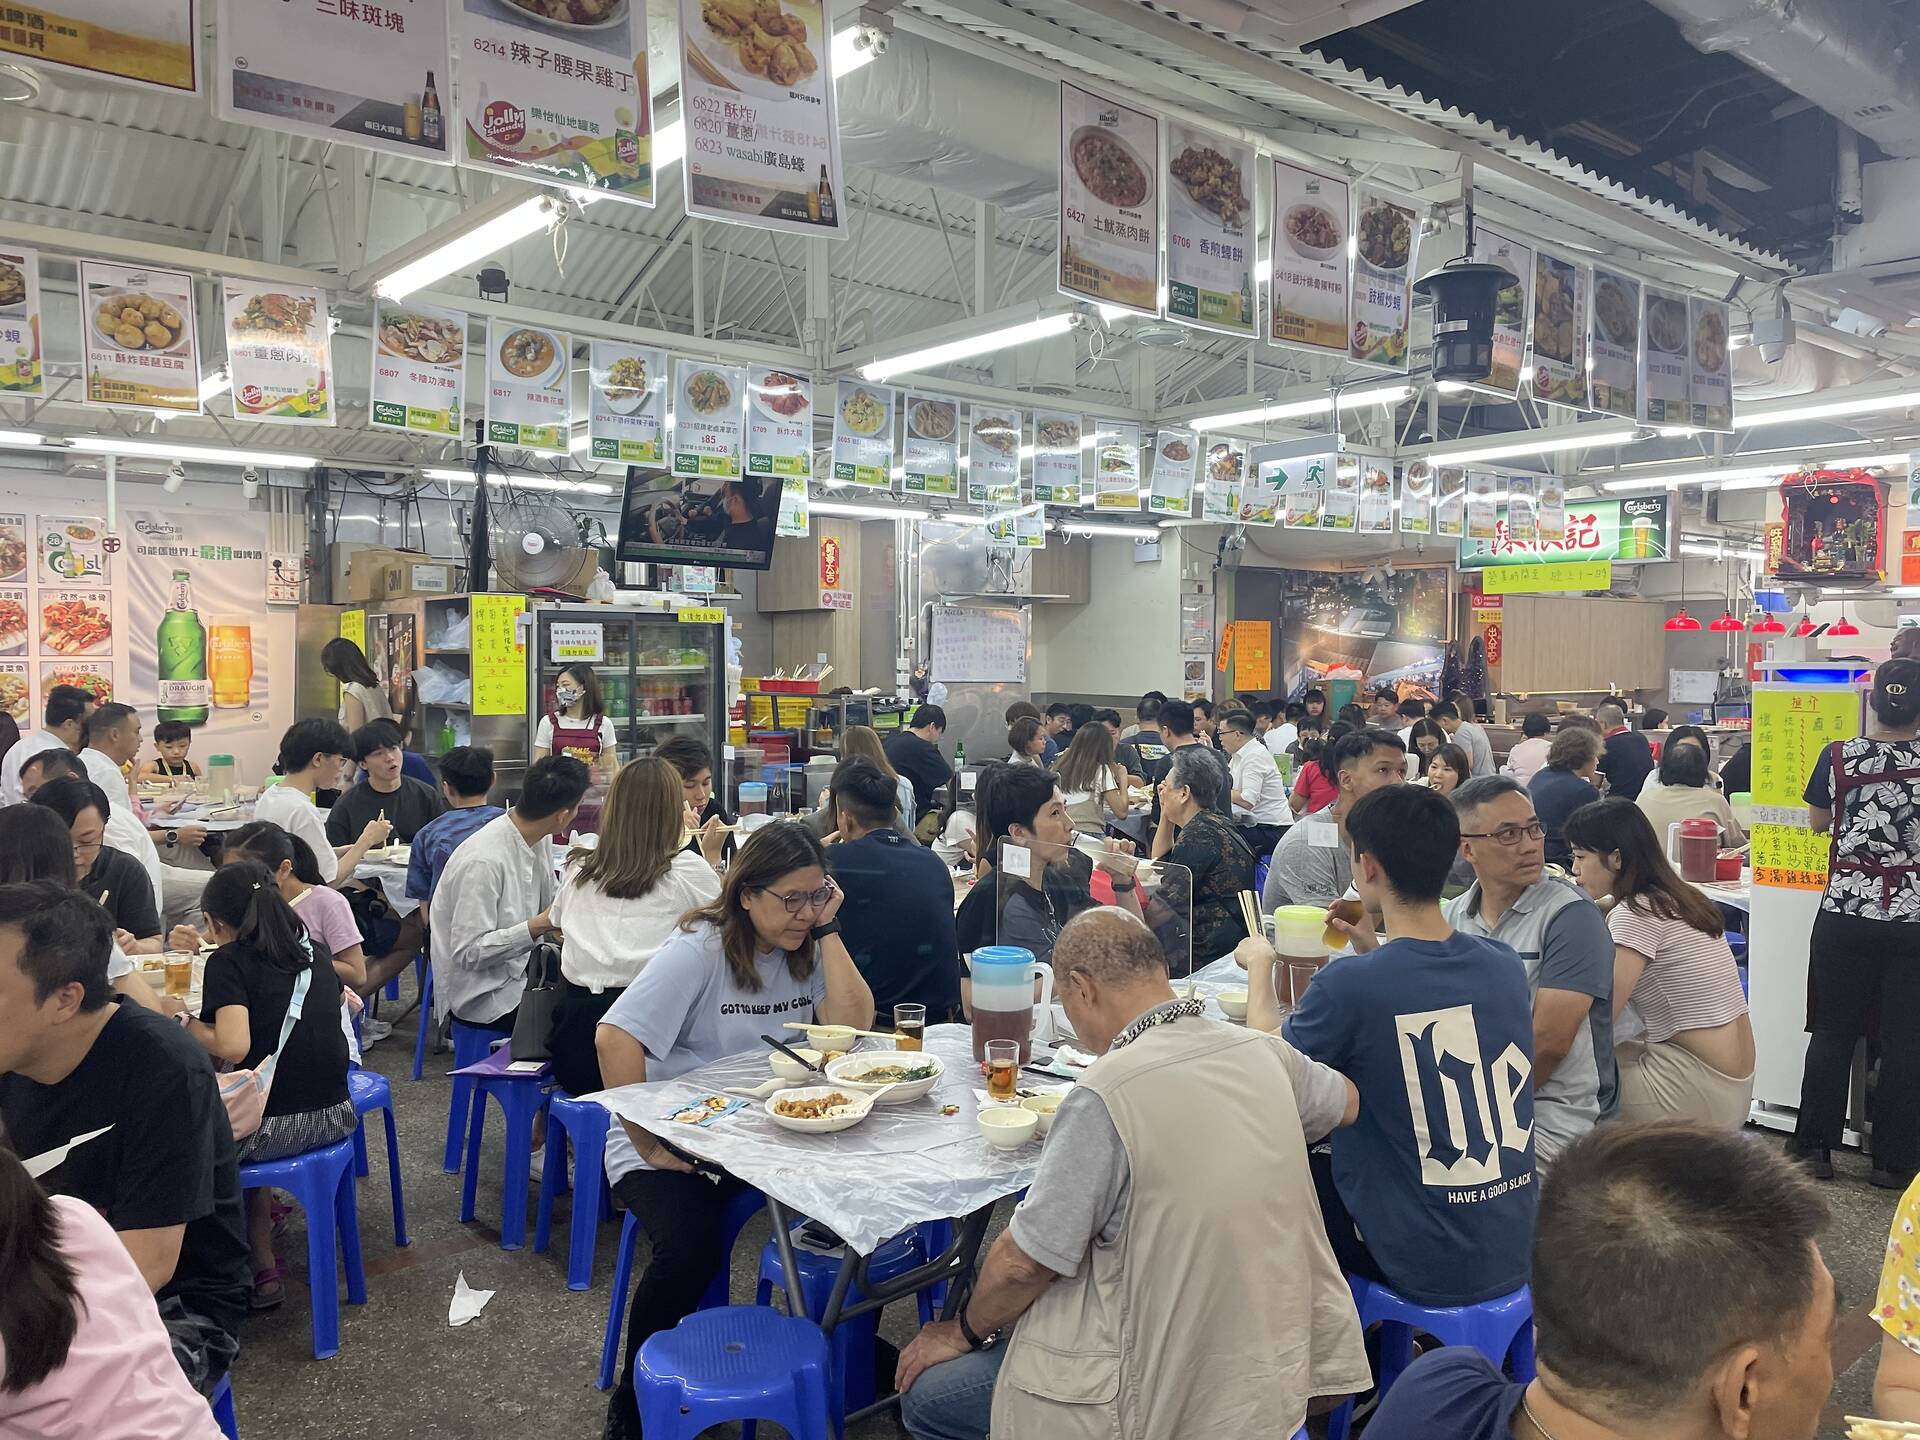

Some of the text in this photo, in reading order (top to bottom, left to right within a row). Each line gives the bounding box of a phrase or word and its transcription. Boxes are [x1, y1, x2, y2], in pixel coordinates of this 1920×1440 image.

[473, 38, 634, 92] 6214 辣子腰果雞丁
[693, 95, 757, 123] 6822 酥炸/
[531, 107, 600, 135] 樂怡仙地罐裝
[694, 117, 722, 134] 6820
[695, 136, 722, 154] 6823
[1066, 207, 1150, 244] 6427 土魷蒸肉餅
[1172, 234, 1191, 249] 6706
[0, 328, 21, 344] 蜆
[379, 368, 400, 378] 6807
[493, 388, 512, 398] 6817
[1624, 499, 1662, 516] Carlsberg
[135, 520, 174, 534] Carlsberg
[388, 569, 402, 591] 3M
[71, 664, 99, 673] 小炒王
[169, 684, 206, 692] DRAUGHT
[751, 1004, 771, 1015] KEEP
[773, 1001, 789, 1013] MY
[1448, 1172, 1532, 1204] HAVE A GOOD SLACK
